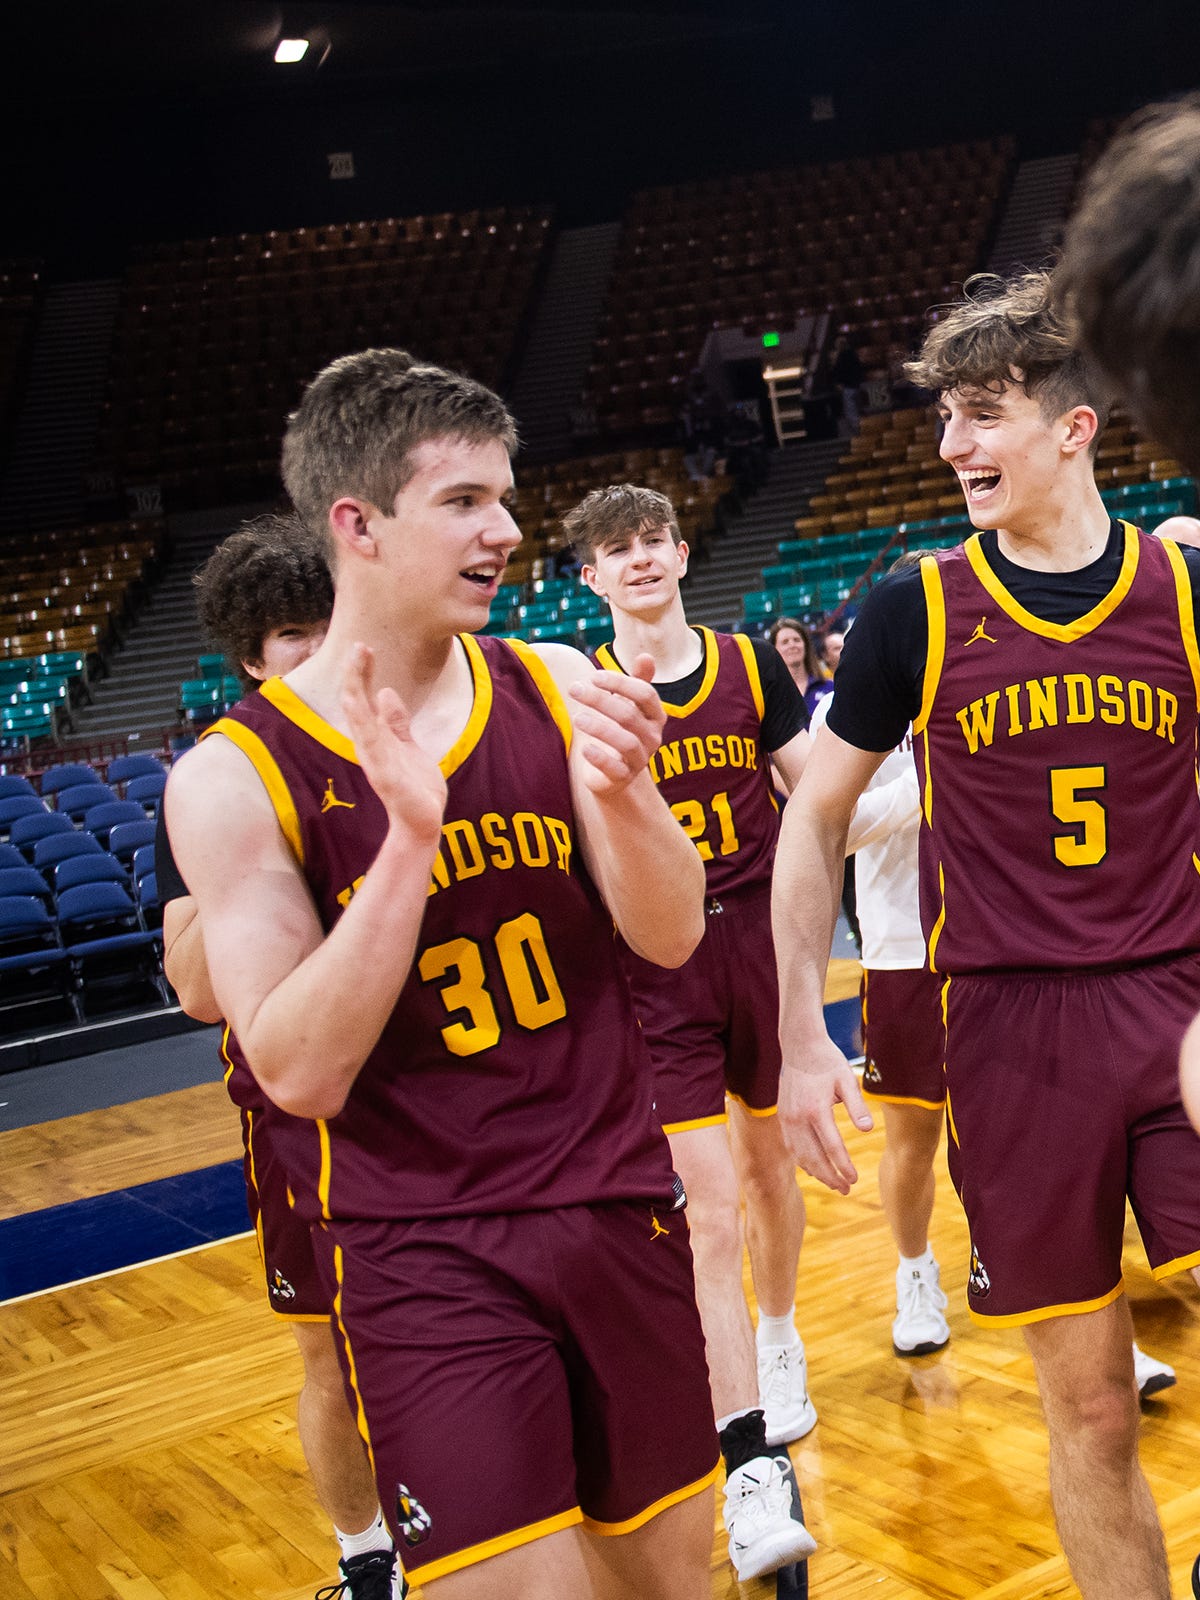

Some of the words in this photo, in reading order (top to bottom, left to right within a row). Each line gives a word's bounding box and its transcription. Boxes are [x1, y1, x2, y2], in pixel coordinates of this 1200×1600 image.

[955, 673, 1178, 754] WINDSOR
[648, 734, 757, 784] INDSOR
[336, 811, 572, 907] NDSOR
[669, 791, 739, 862] 21
[1047, 763, 1108, 868] 5
[416, 911, 569, 1059] 30
